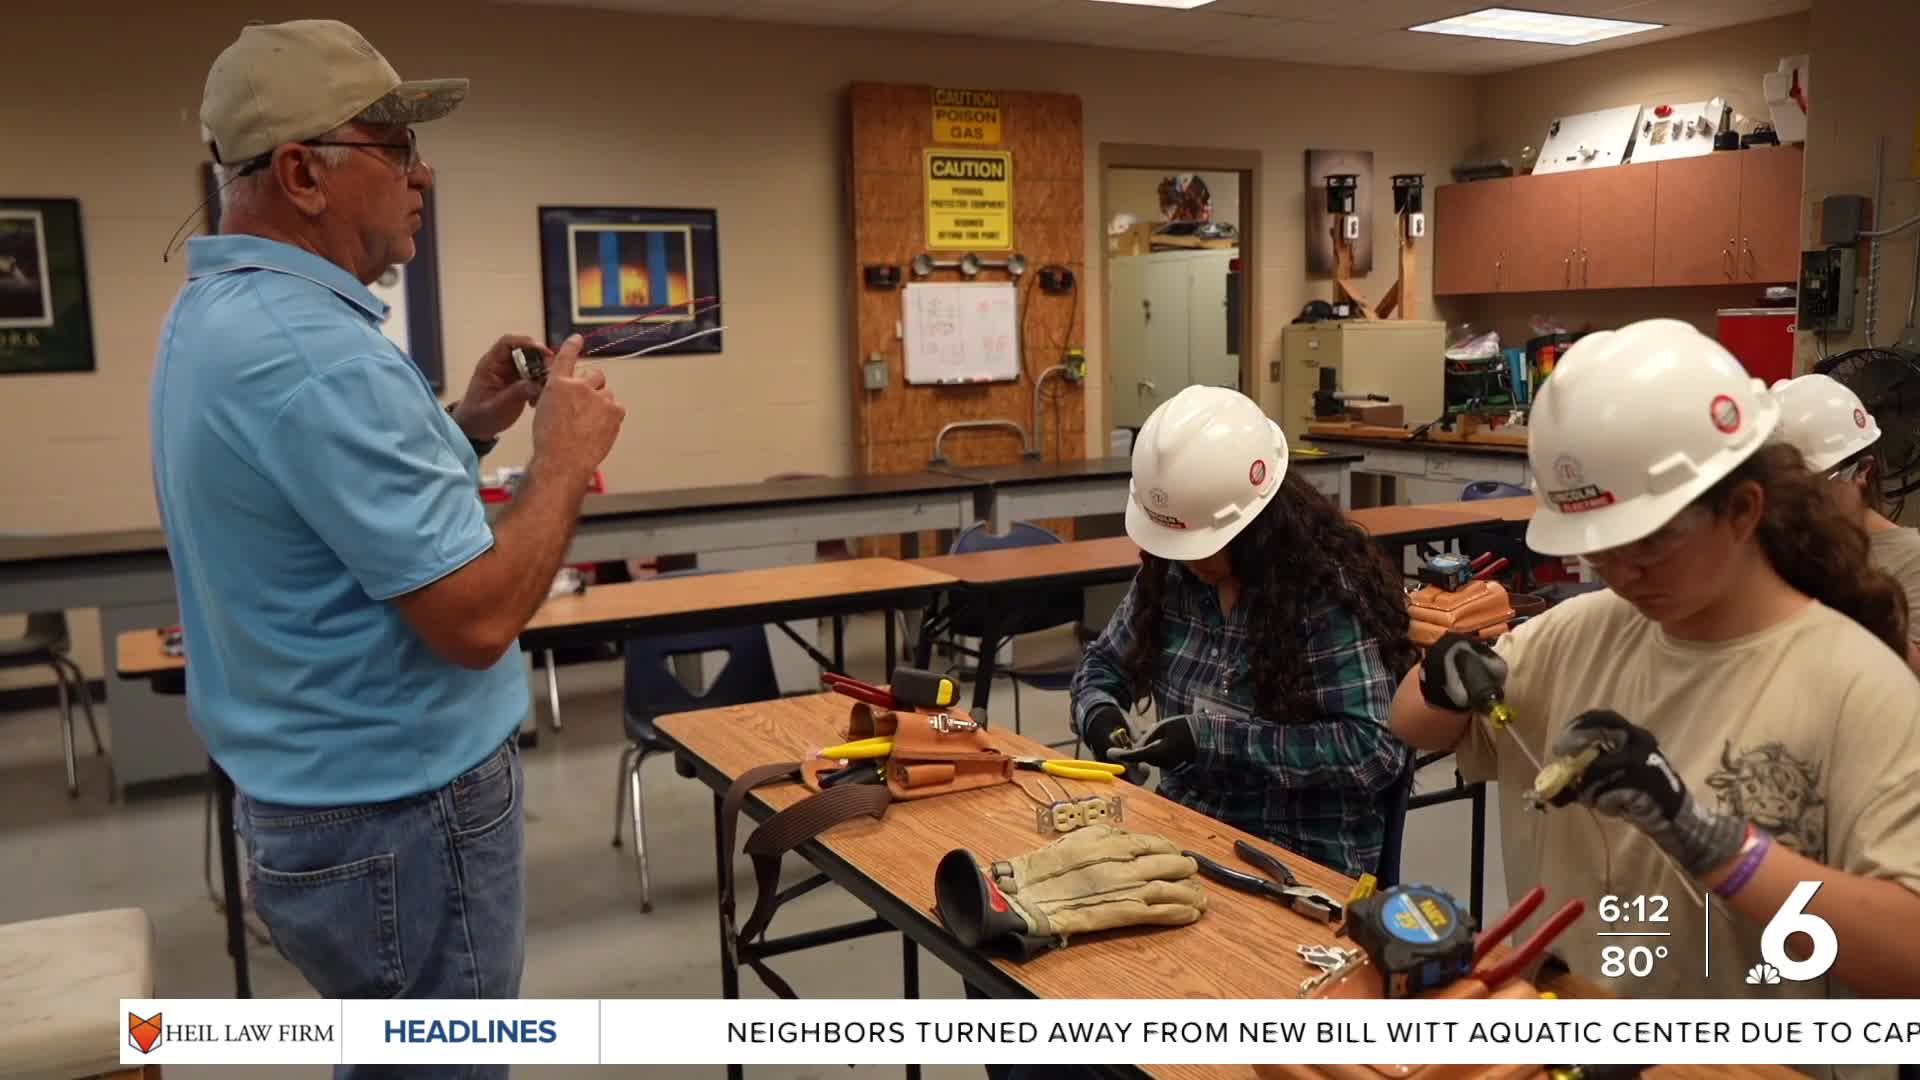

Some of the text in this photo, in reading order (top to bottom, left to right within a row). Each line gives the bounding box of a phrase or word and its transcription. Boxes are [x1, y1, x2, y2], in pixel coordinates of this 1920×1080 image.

[936, 89, 997, 107] CAUTION
[936, 109, 997, 123] POISON
[951, 126, 984, 139] GAS
[932, 160, 1003, 178] CAUTION
